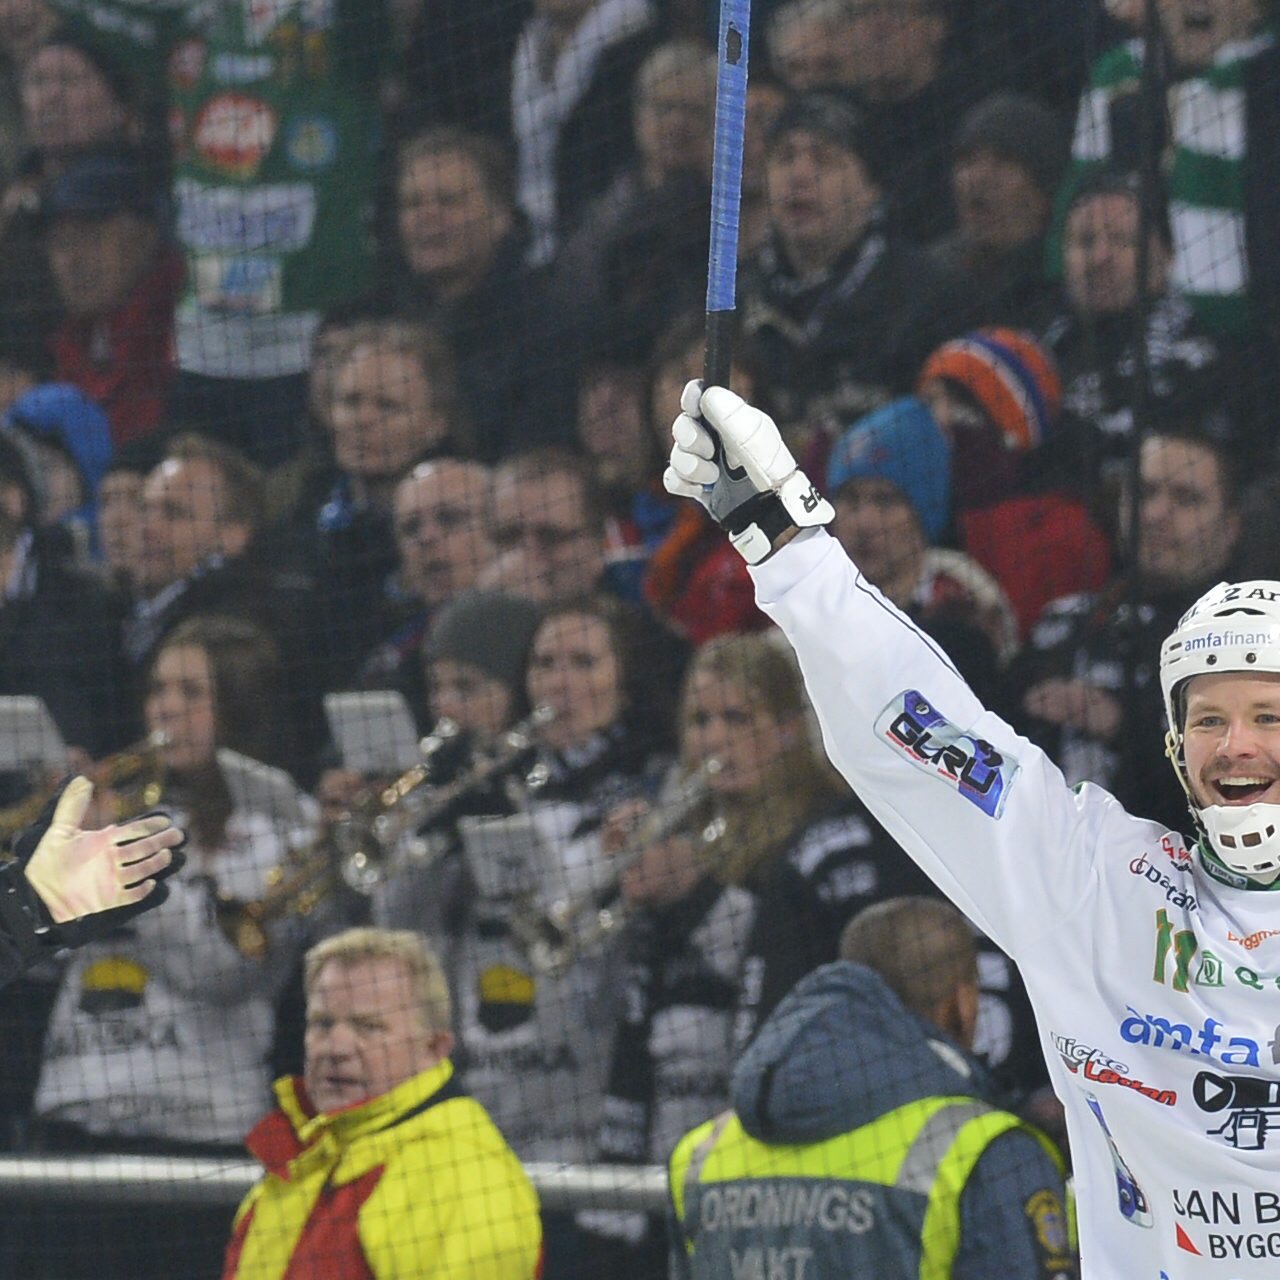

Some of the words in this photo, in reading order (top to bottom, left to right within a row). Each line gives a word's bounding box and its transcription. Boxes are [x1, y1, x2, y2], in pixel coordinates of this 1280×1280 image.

[889, 712, 998, 794] GURU
[1234, 966, 1264, 991] Q
[701, 1184, 875, 1235] ORDNINGS
